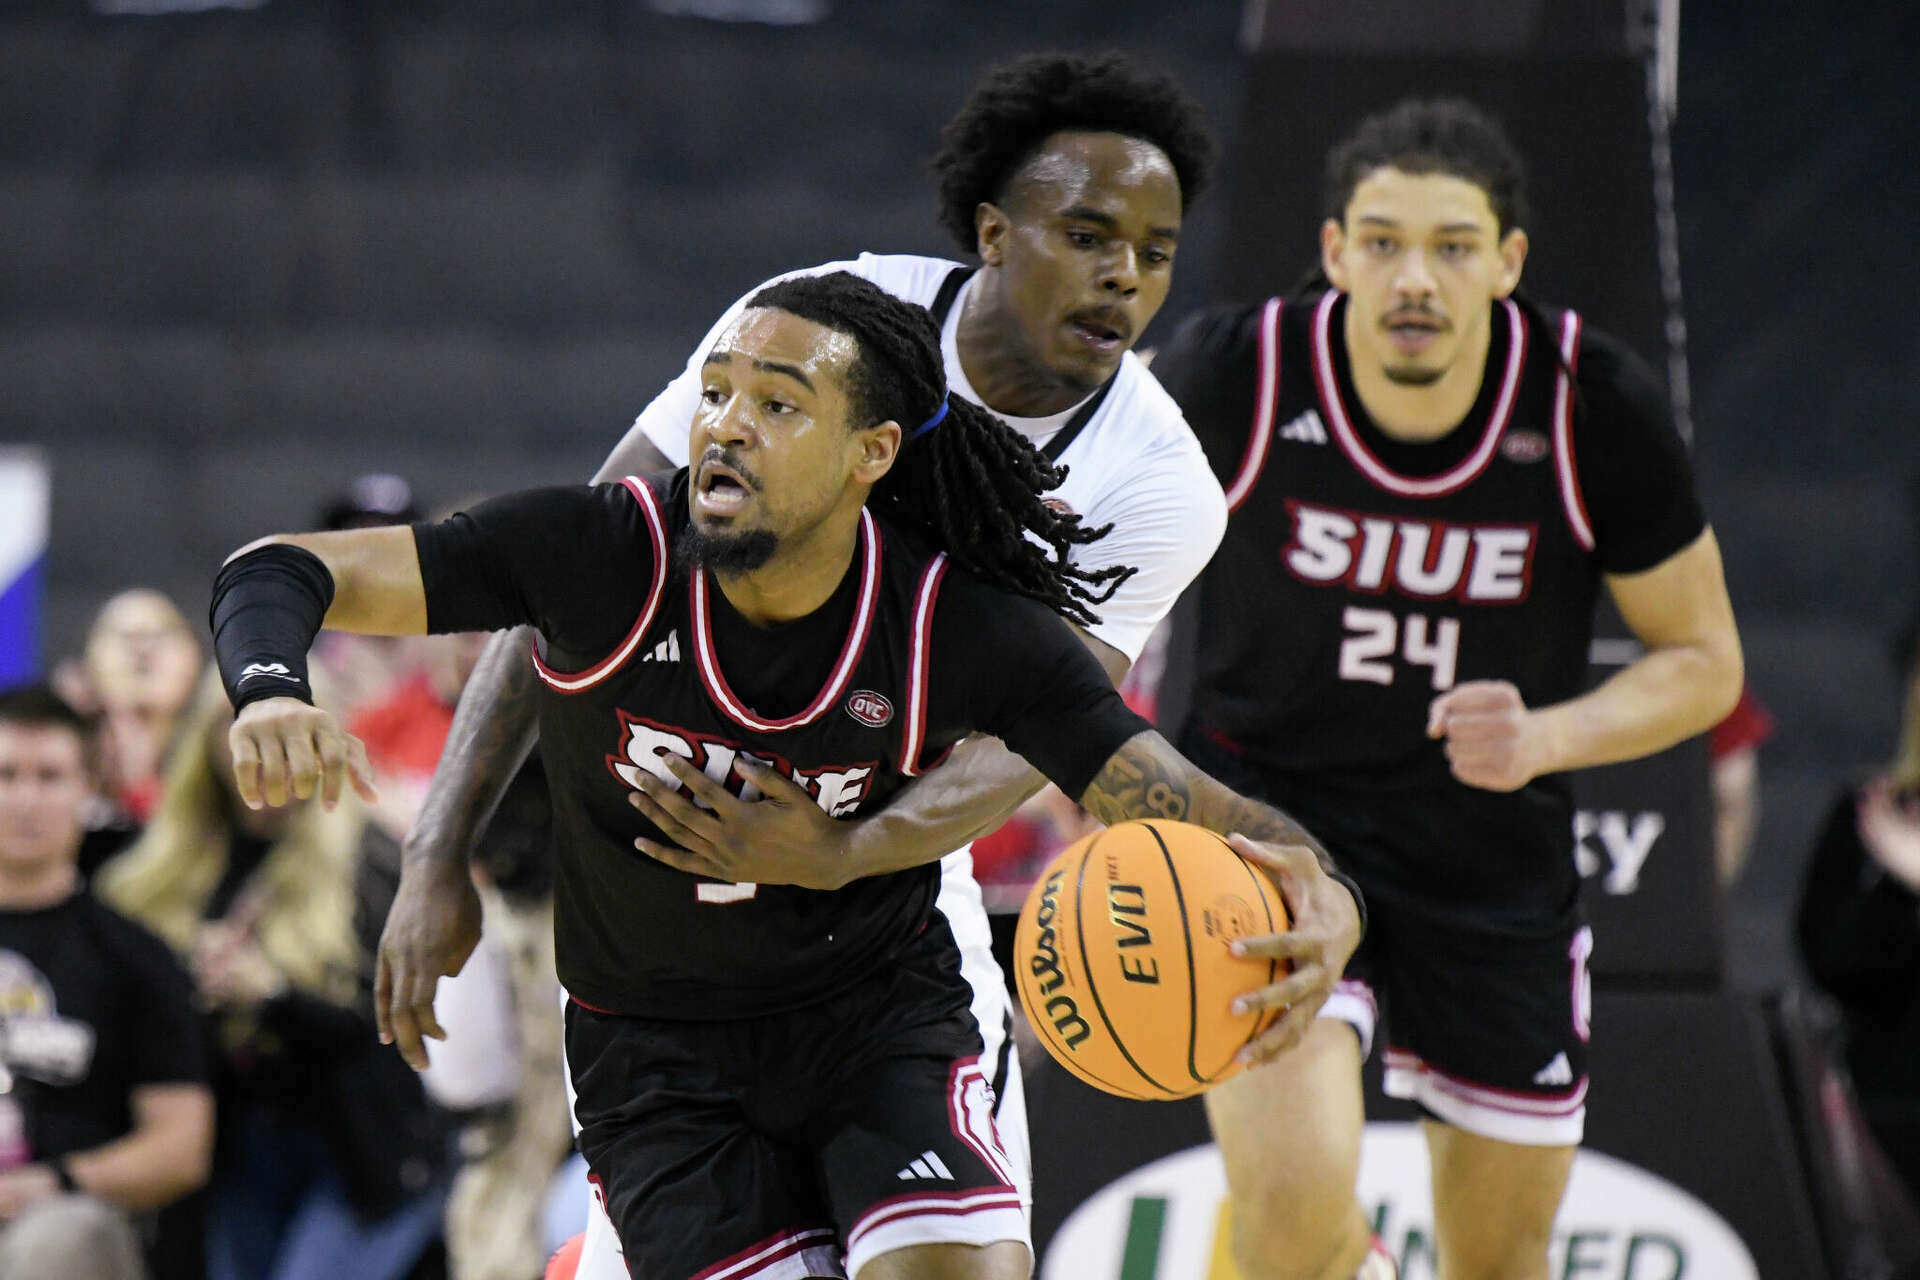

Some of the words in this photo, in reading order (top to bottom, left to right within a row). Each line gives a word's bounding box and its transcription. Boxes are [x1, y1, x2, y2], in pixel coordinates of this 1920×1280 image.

[1284, 503, 1535, 602] SIUE
[1338, 606, 1460, 692] 24
[853, 698, 884, 719] OVC
[1031, 869, 1091, 1051] Wilson
[1108, 883, 1161, 985] EVO
